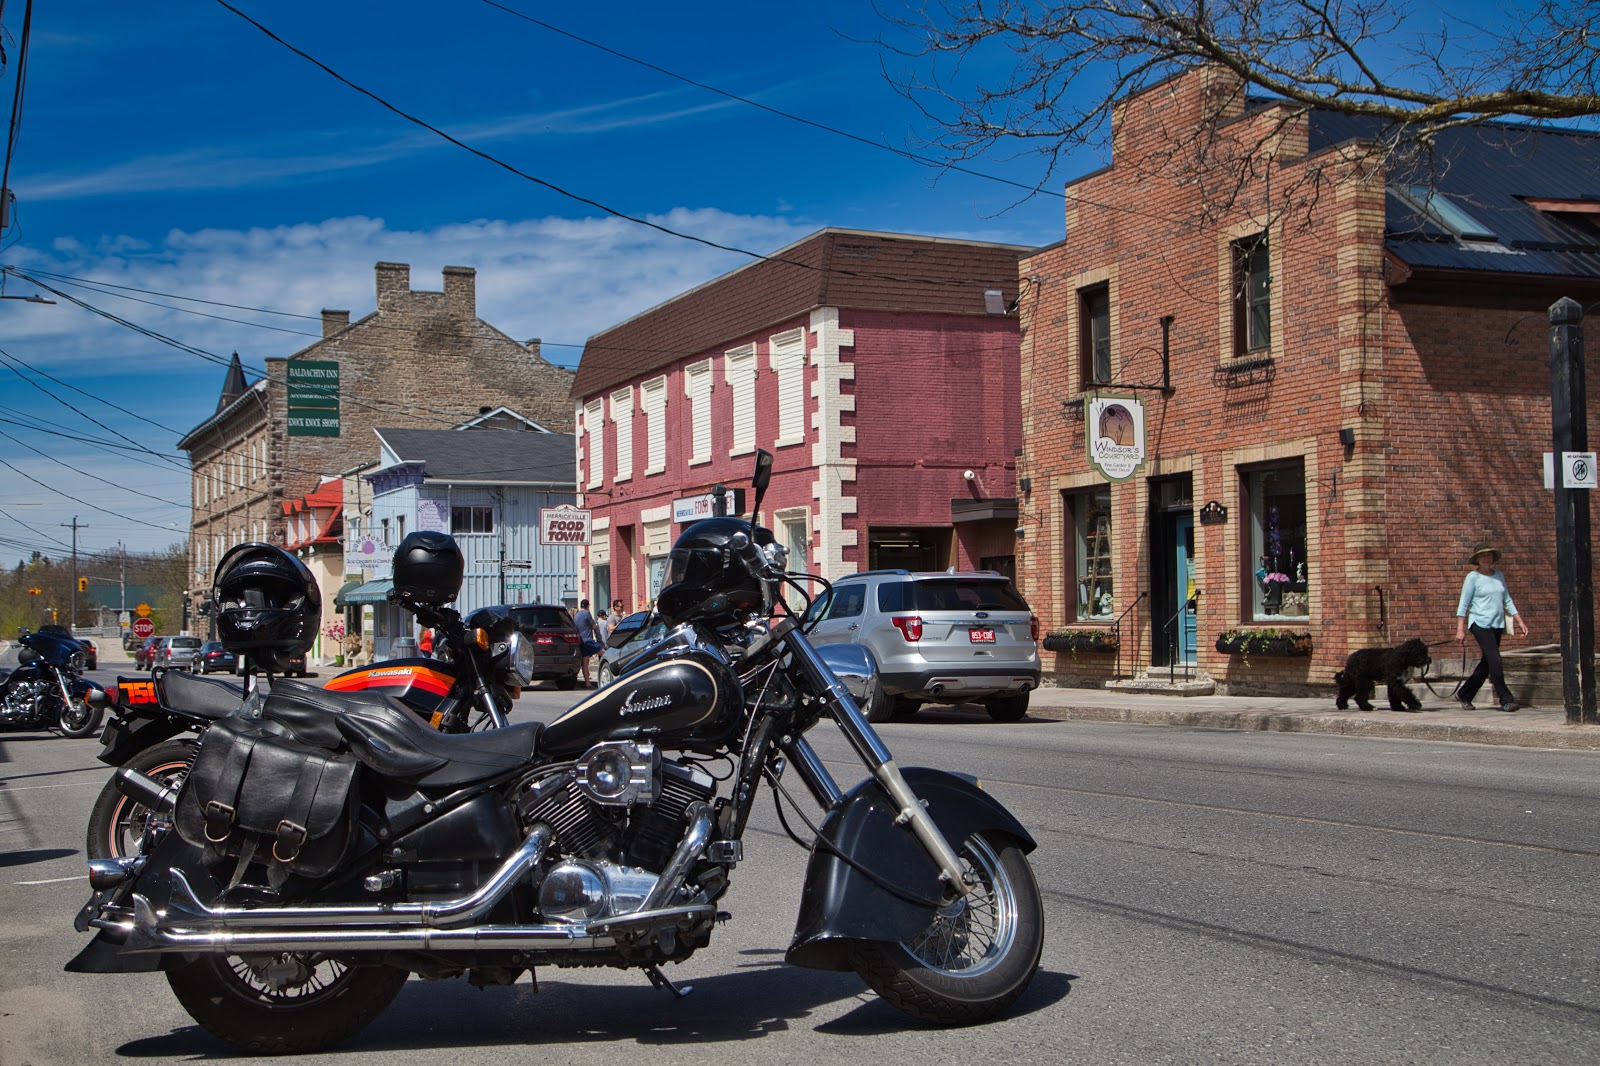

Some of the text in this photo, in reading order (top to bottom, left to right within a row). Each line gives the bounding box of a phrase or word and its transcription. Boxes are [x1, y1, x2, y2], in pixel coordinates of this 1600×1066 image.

[289, 368, 338, 378] BALDACHIN INN
[288, 418, 304, 427] KNOCK
[305, 418, 321, 427] KNOCK
[1098, 451, 1139, 461] COURTYARD
[549, 520, 585, 531] FOOD
[548, 531, 586, 542] TOWN
[135, 624, 153, 633] STOP
[368, 668, 413, 678] Kawasaki
